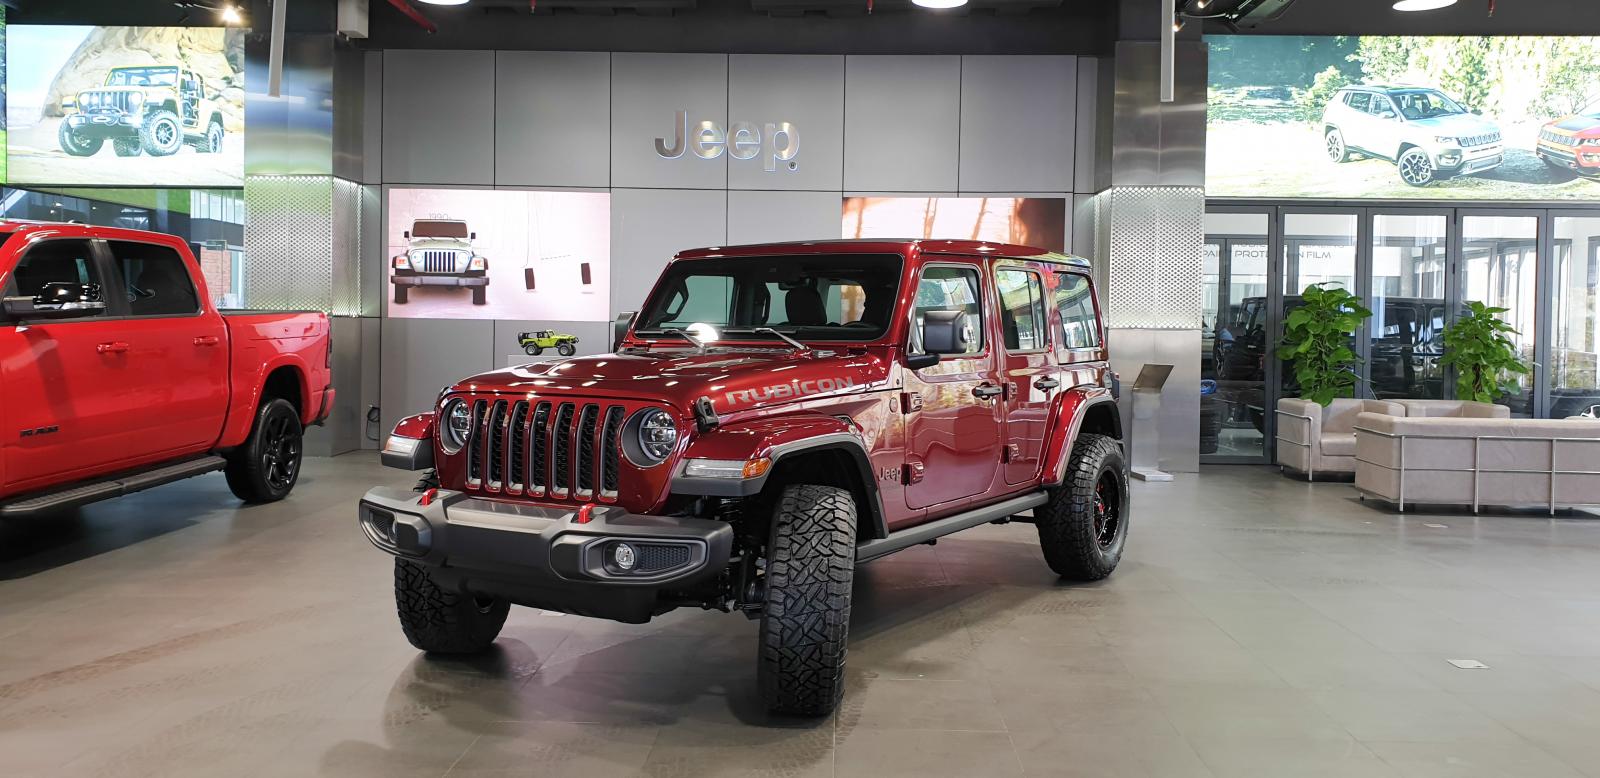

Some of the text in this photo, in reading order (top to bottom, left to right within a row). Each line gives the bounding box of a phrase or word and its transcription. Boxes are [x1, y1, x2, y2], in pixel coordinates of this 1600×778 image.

[655, 110, 800, 172] Jeep
[1306, 250, 1332, 259] FILM
[725, 376, 854, 405] RUBICON
[879, 466, 902, 481] Jeep
